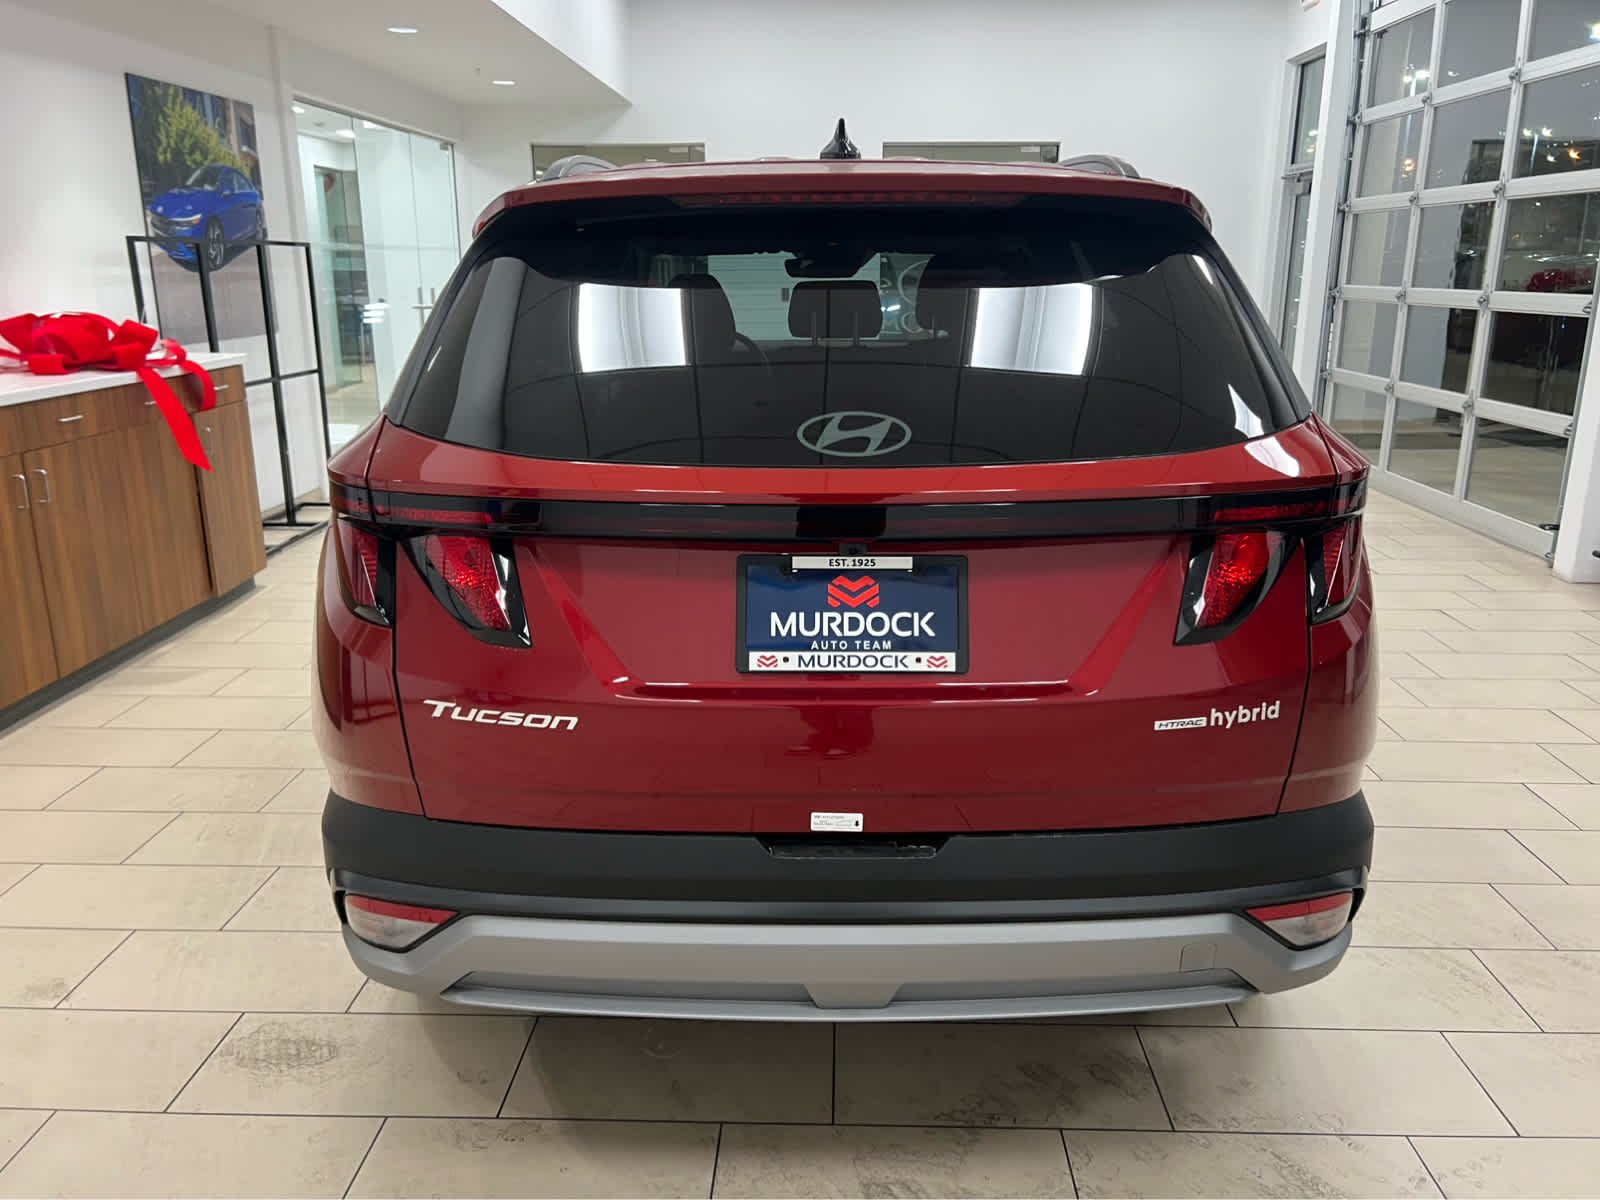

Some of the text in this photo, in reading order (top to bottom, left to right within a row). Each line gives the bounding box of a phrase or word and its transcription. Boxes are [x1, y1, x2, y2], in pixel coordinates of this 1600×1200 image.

[828, 558, 876, 567] EST. 1925
[770, 611, 936, 637] MURDOCK
[811, 640, 892, 650] AUTO TEAM
[798, 654, 909, 669] MURDOCK
[1157, 700, 1281, 729] HTRAC hybrid
